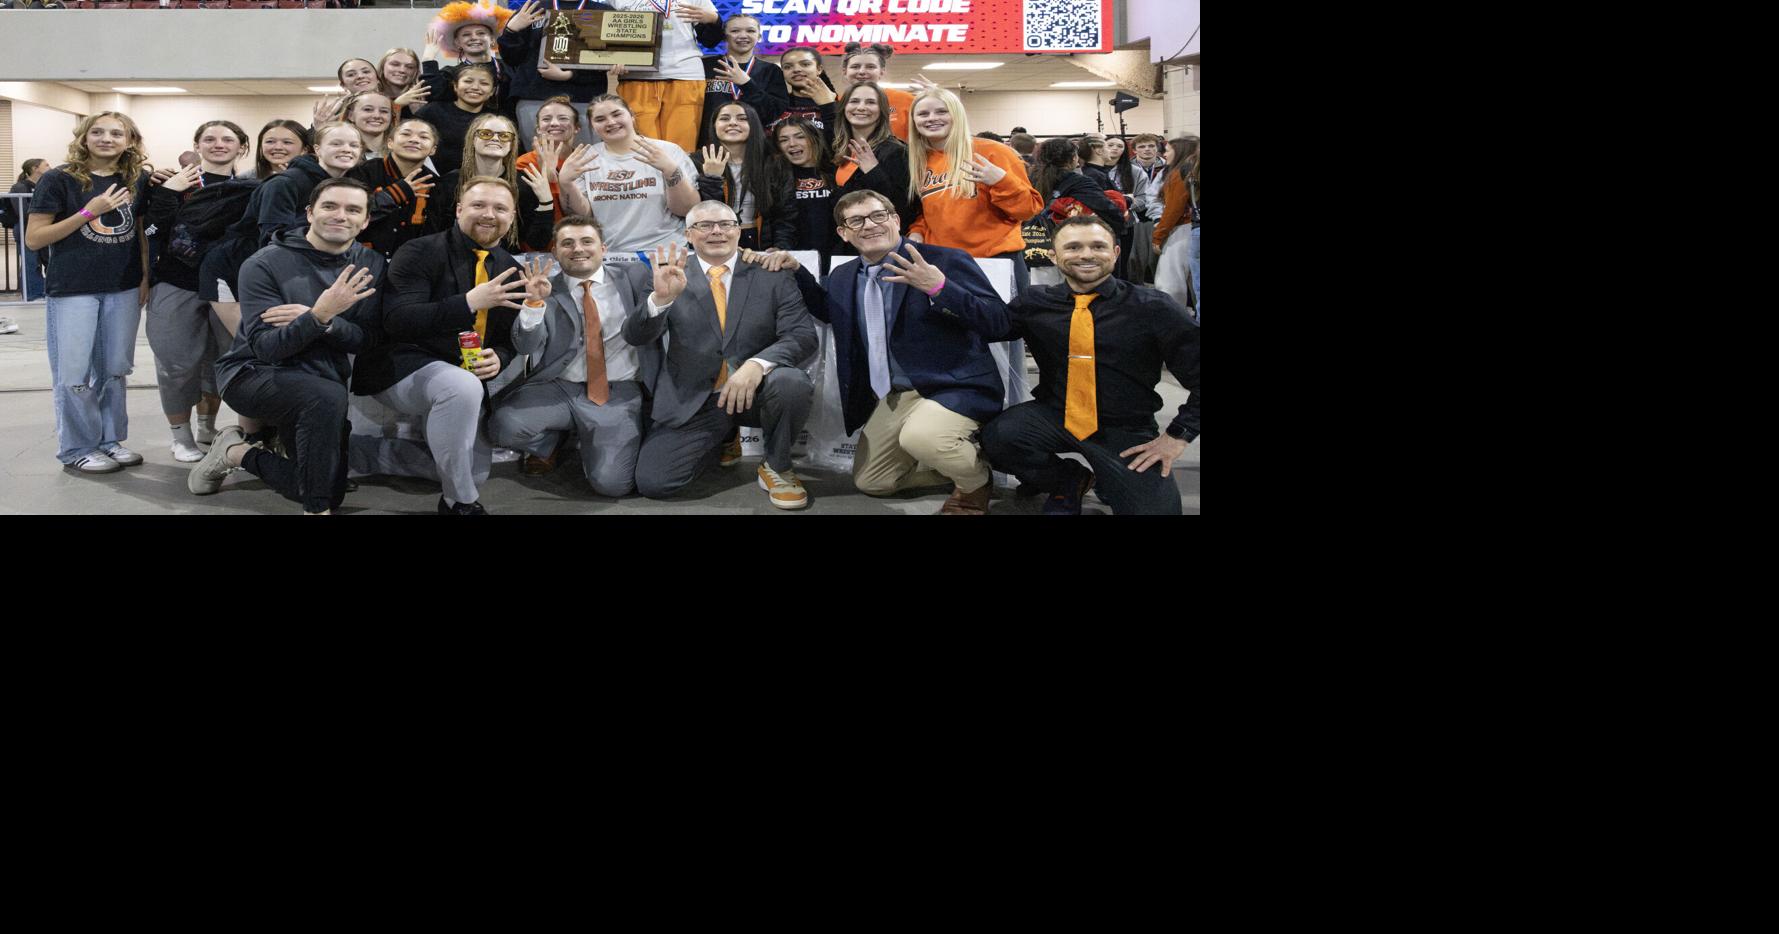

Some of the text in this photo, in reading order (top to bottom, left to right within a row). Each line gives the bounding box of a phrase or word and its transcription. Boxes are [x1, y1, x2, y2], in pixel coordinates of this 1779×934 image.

[741, 0, 971, 16] SCAN QR CODE
[758, 25, 969, 43] TO NOMINATE
[589, 178, 657, 192] WRESTLING
[619, 192, 648, 201] NATION
